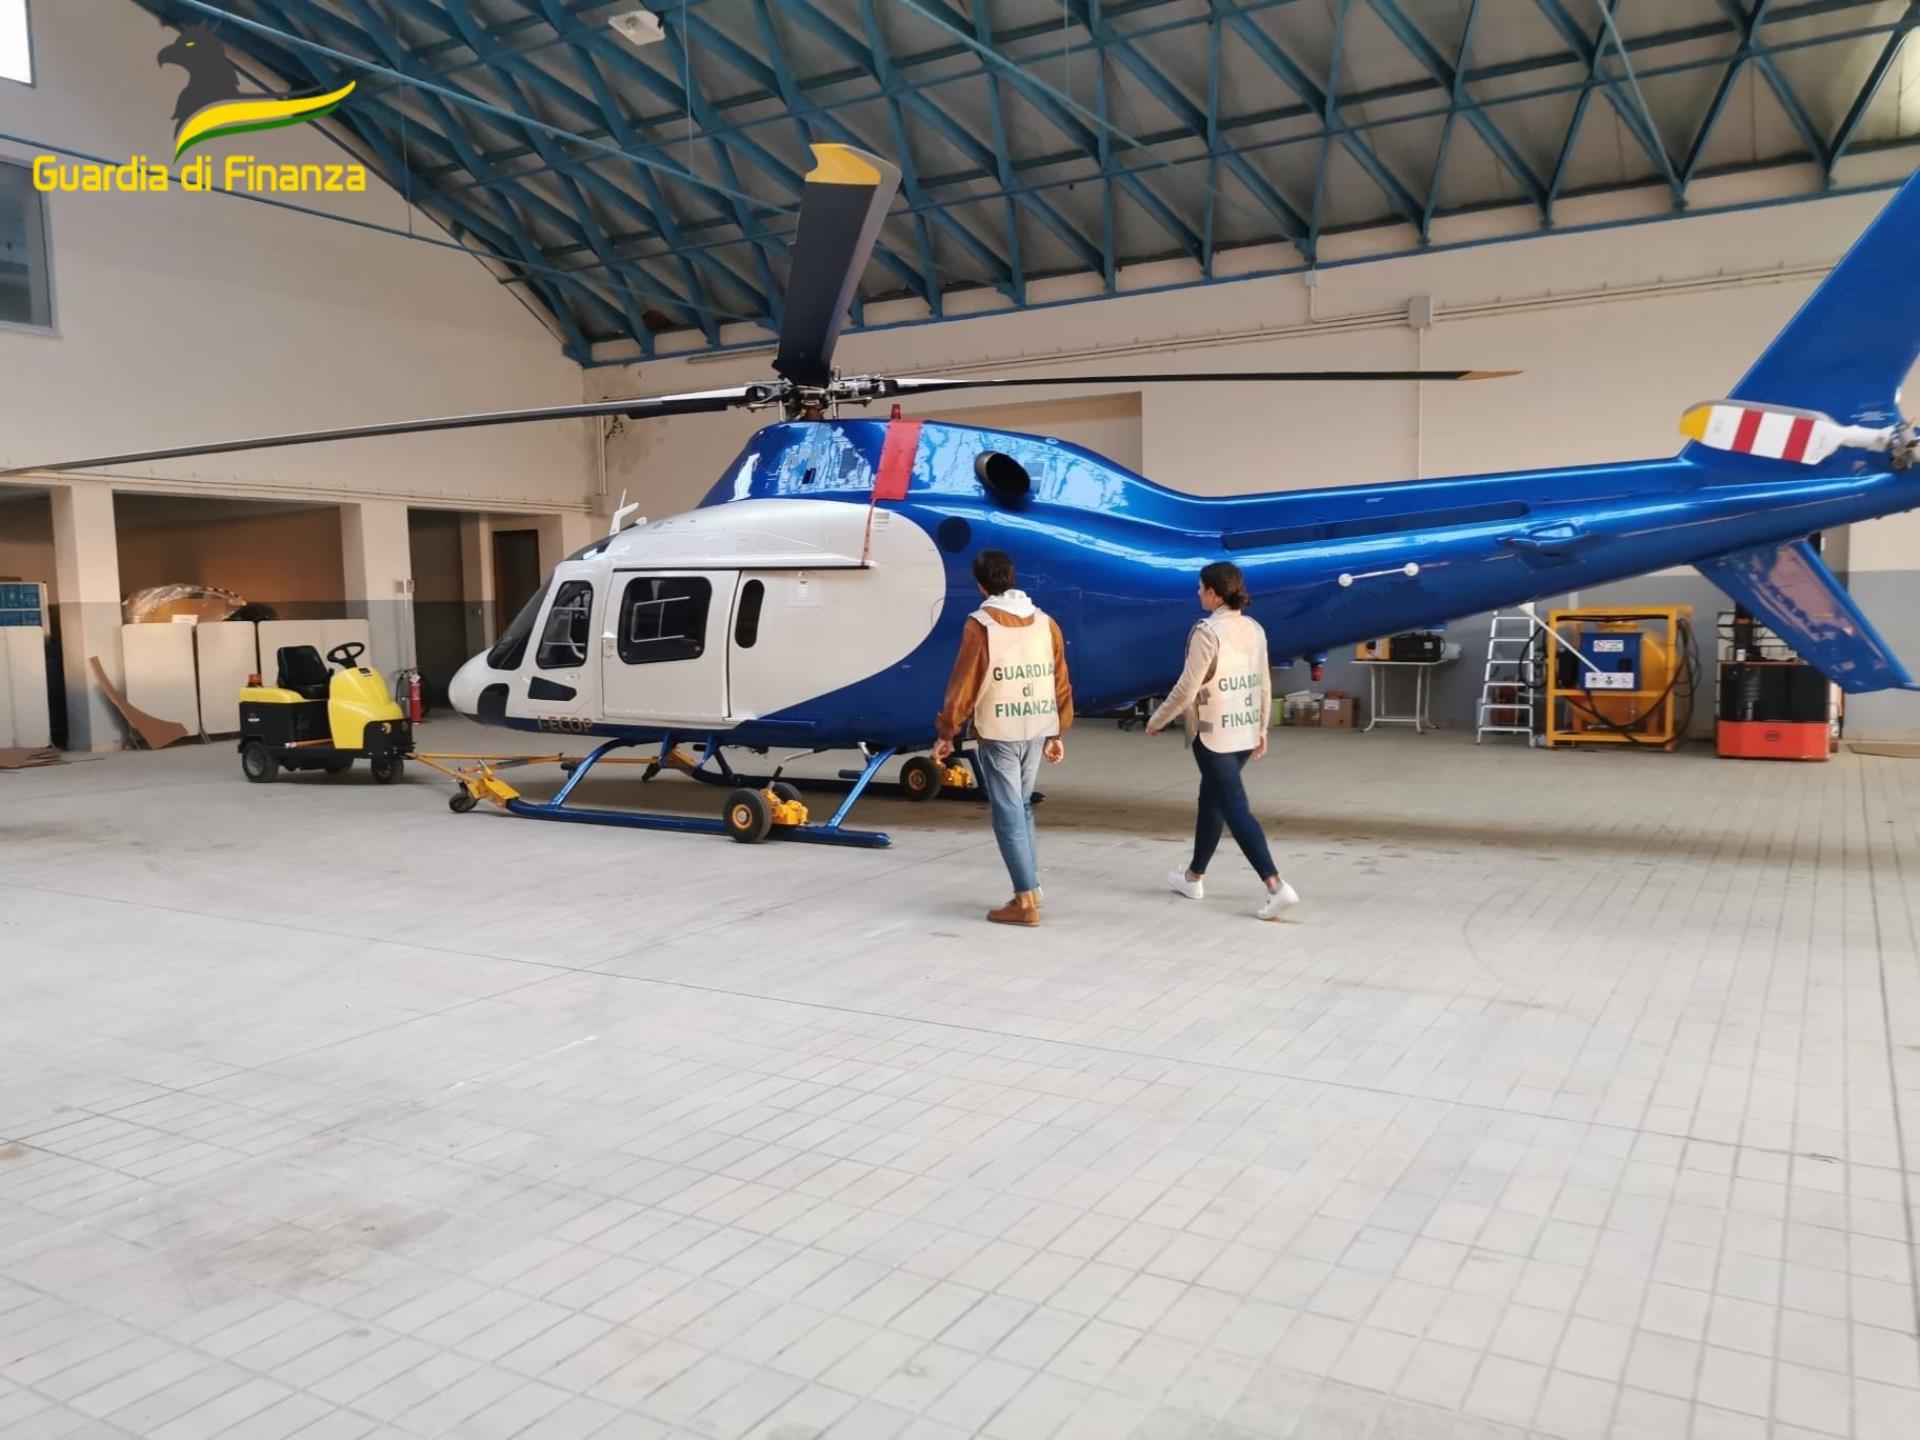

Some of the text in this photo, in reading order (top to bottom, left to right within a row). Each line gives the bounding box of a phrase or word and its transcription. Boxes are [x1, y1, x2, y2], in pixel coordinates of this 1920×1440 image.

[992, 663, 1055, 681] GUARDIA
[1022, 683, 1033, 697] di
[995, 699, 1057, 718] FINANZA
